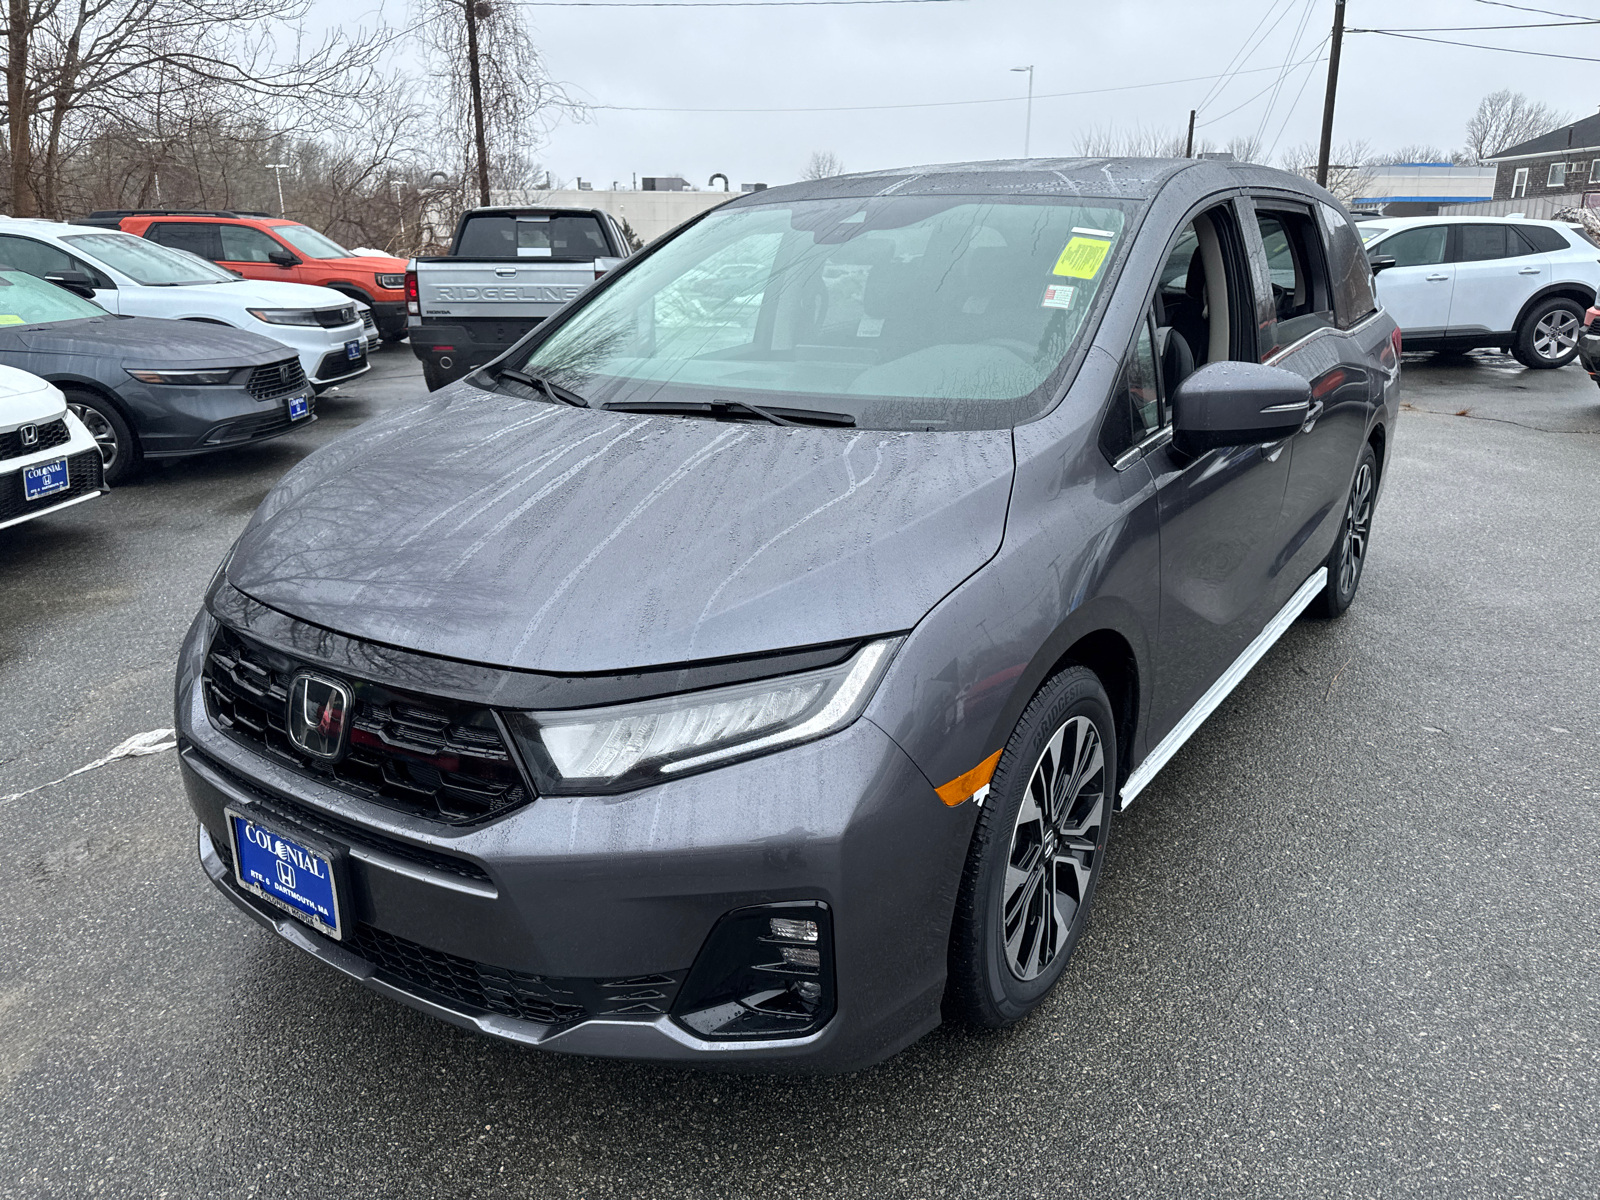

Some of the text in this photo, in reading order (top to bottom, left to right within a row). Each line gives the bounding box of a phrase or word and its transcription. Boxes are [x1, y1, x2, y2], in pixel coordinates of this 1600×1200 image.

[435, 285, 579, 301] RIDGELINE
[28, 464, 62, 479] COLONIAL
[1033, 682, 1085, 752] BRIDGESTO
[245, 825, 324, 879] COLONIAL
[250, 869, 265, 882] RTE.
[274, 883, 317, 912] DARTMOUTH,
[317, 905, 329, 916] MA
